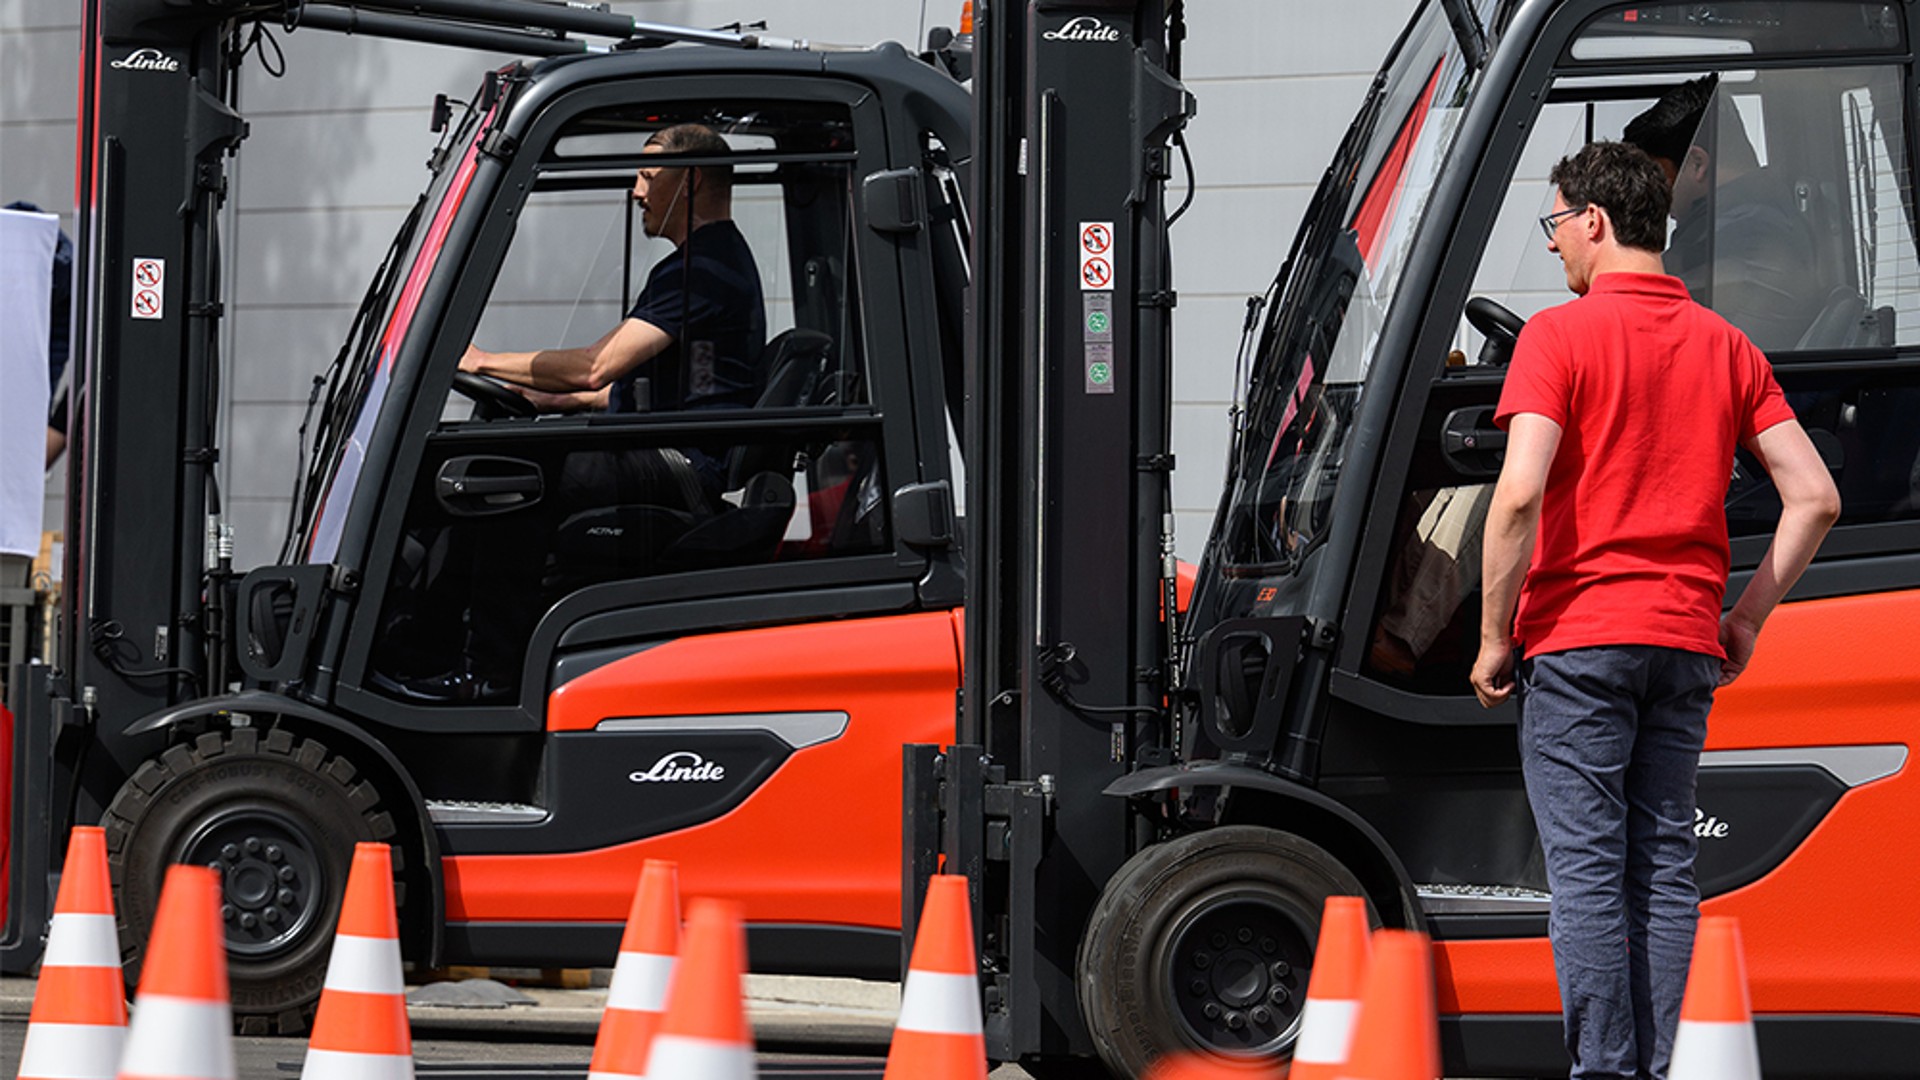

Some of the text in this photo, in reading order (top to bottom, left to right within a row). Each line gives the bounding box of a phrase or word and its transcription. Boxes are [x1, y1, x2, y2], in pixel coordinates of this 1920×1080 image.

[1042, 16, 1119, 42] Linde
[110, 47, 179, 72] Linde
[628, 751, 725, 782] Linde
